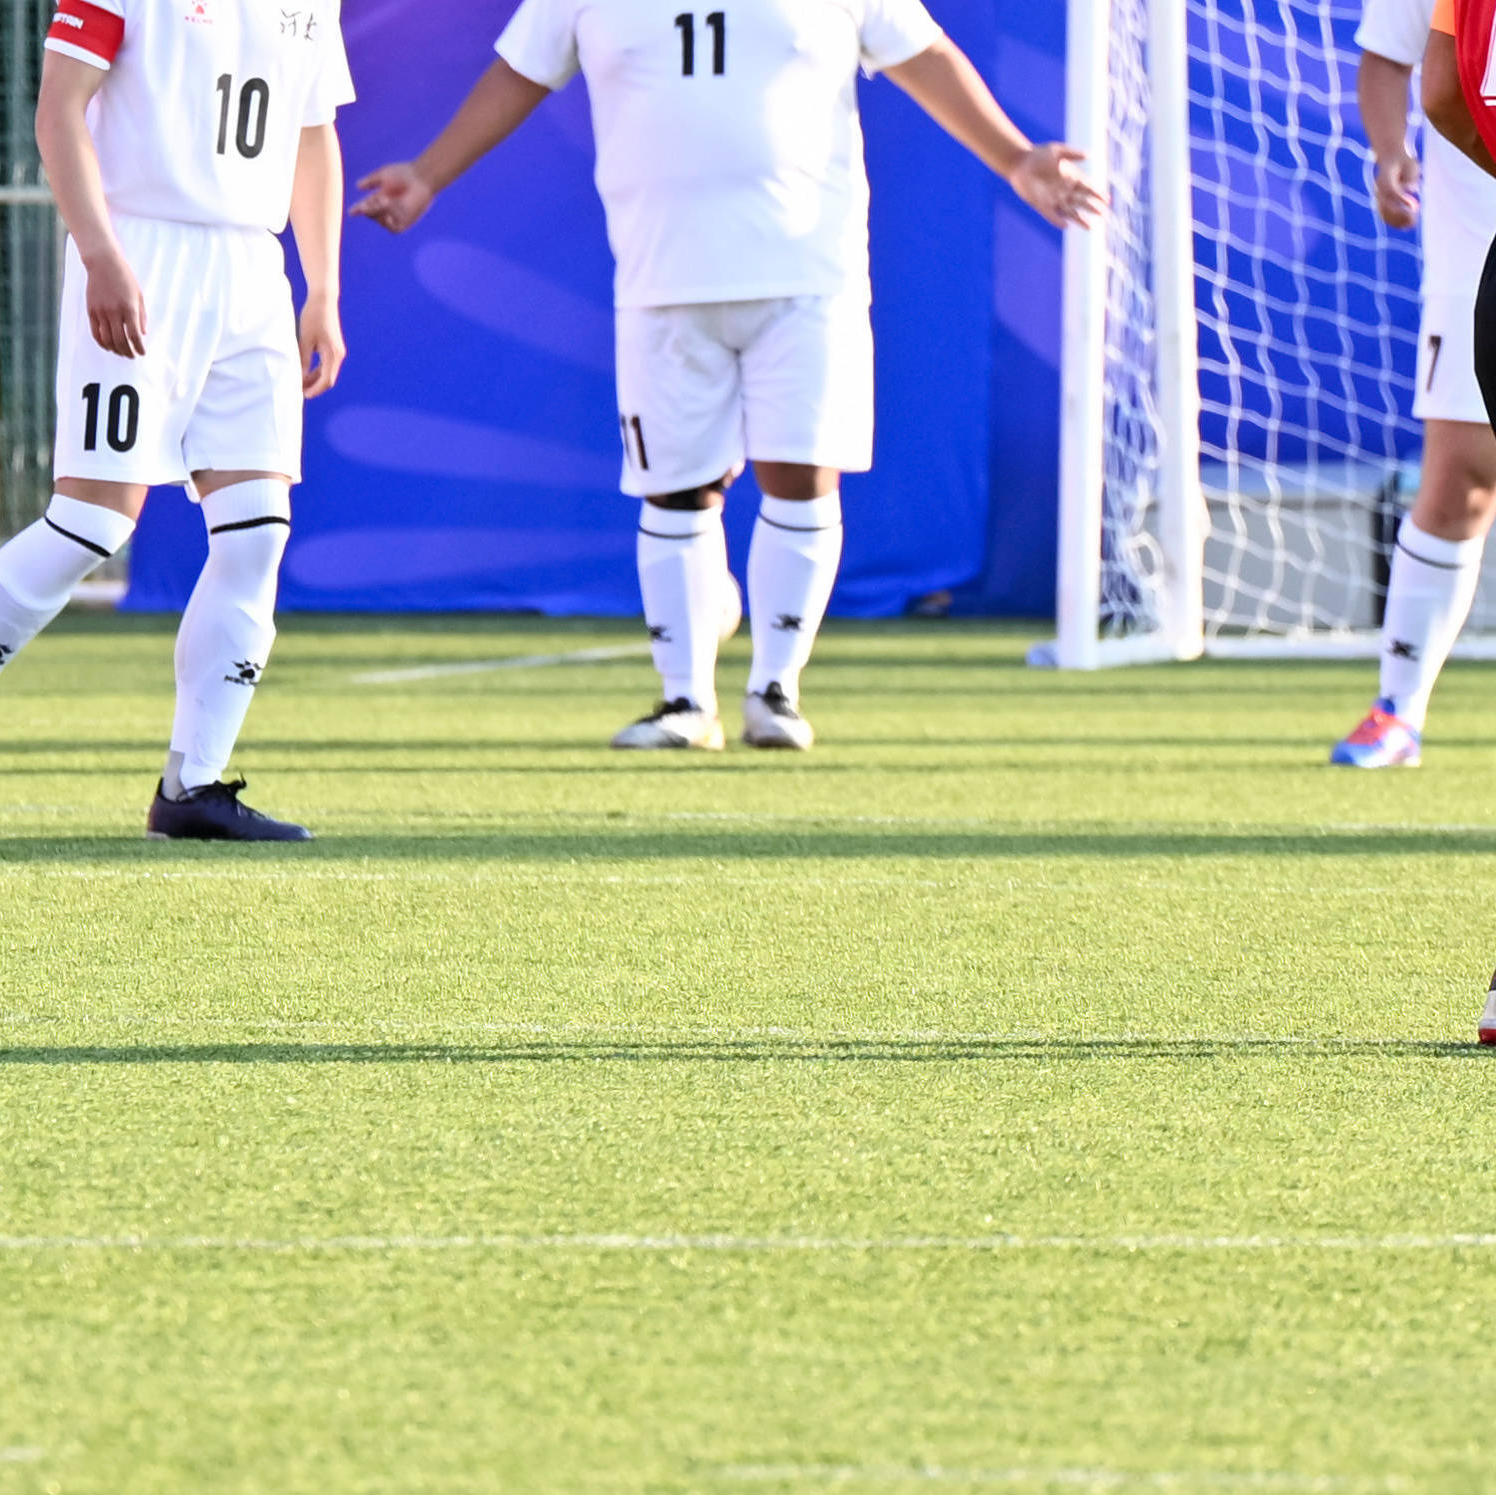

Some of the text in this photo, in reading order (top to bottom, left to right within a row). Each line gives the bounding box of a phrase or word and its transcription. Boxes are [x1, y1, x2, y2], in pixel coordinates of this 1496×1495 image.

[674, 11, 725, 76] 11
[216, 73, 269, 159] 10
[1426, 335, 1443, 392] 7
[82, 382, 140, 453] 10
